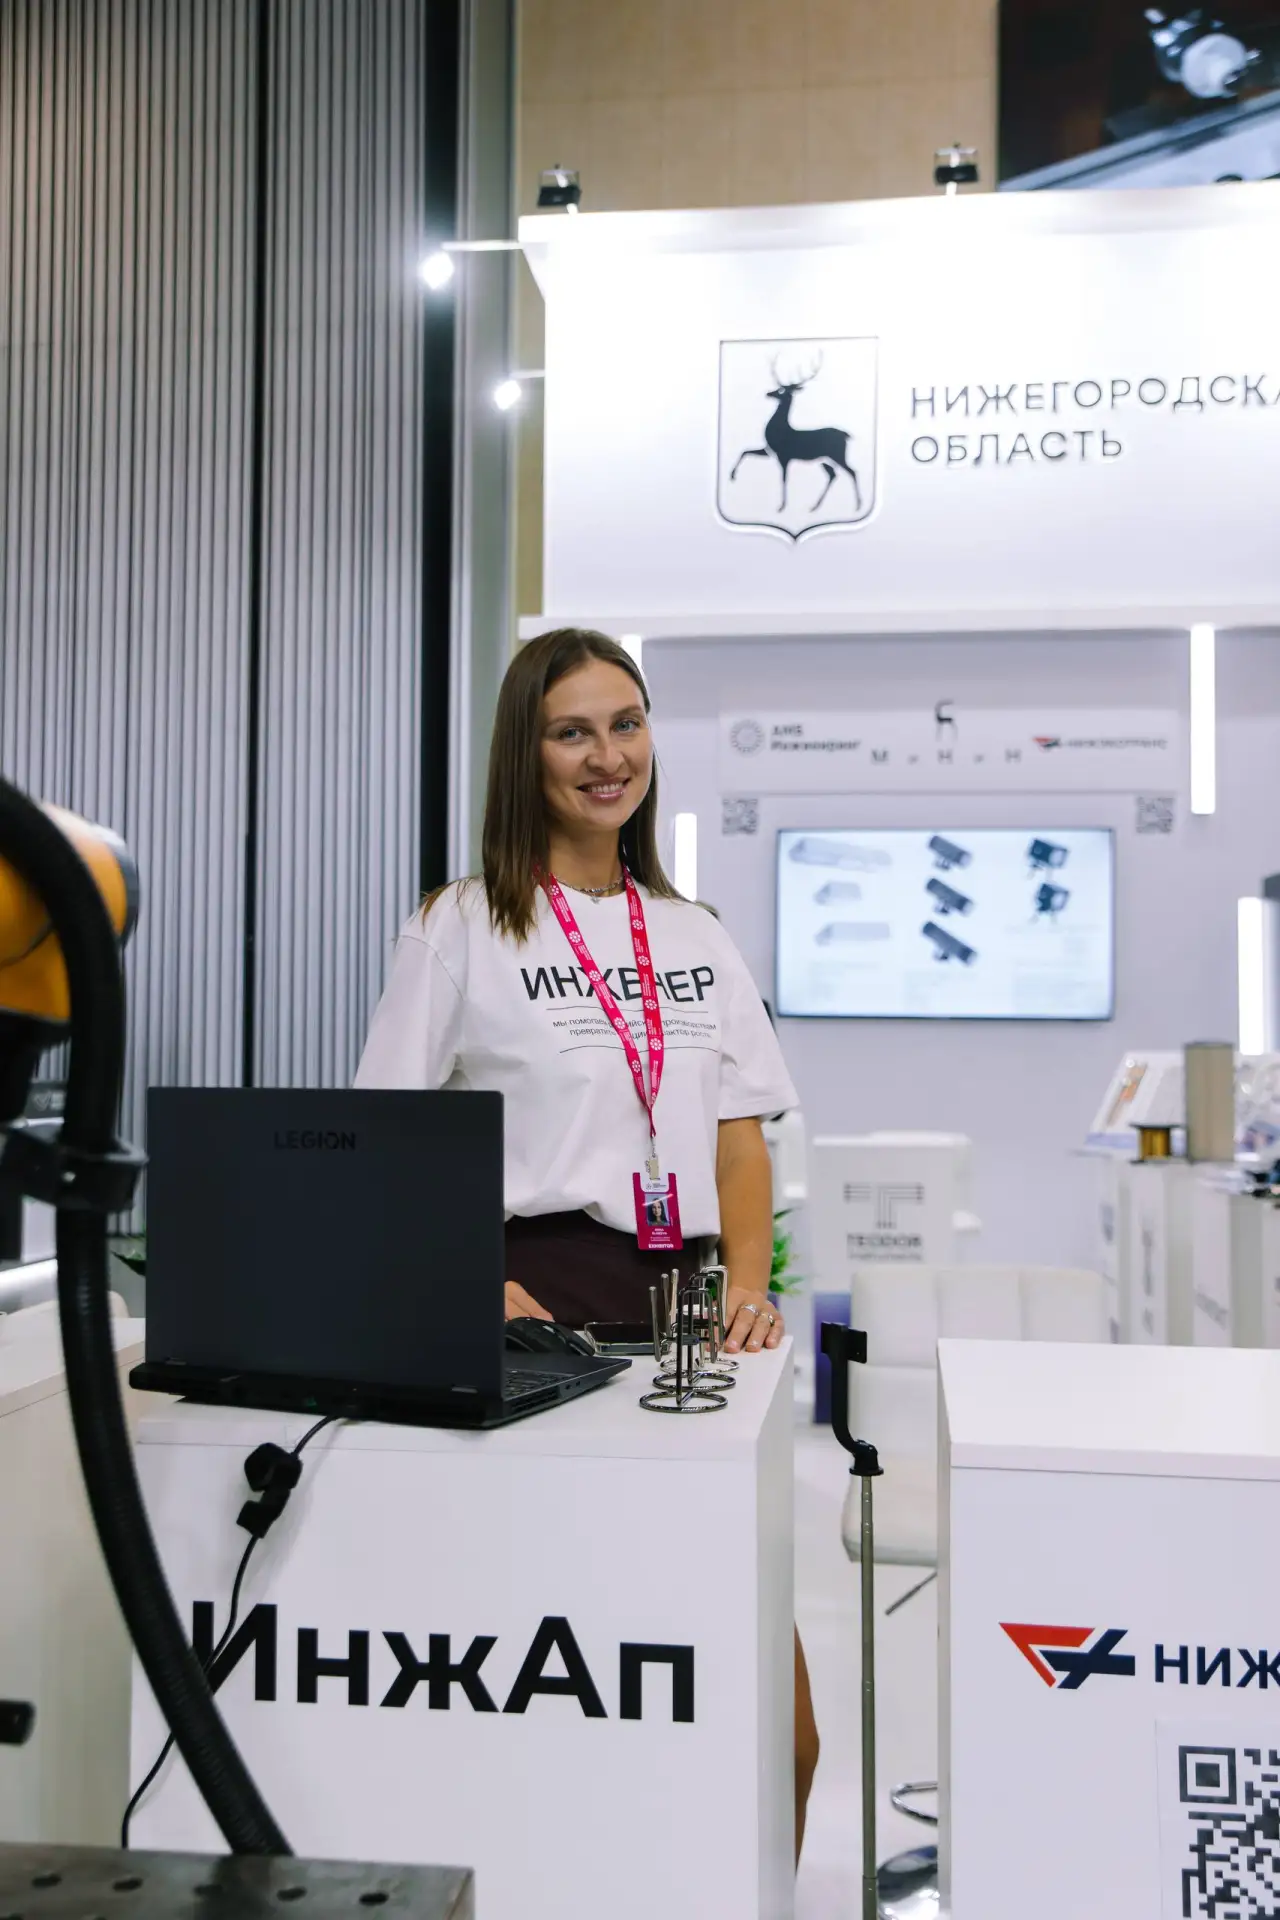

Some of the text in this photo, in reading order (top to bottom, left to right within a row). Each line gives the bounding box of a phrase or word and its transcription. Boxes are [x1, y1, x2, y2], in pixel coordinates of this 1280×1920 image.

[911, 430, 1124, 467] ОБЛАСТЬ
[273, 1130, 357, 1150] LEGION
[193, 1600, 695, 1723] ИнжАп
[1154, 1643, 1280, 1690] НИЖ
